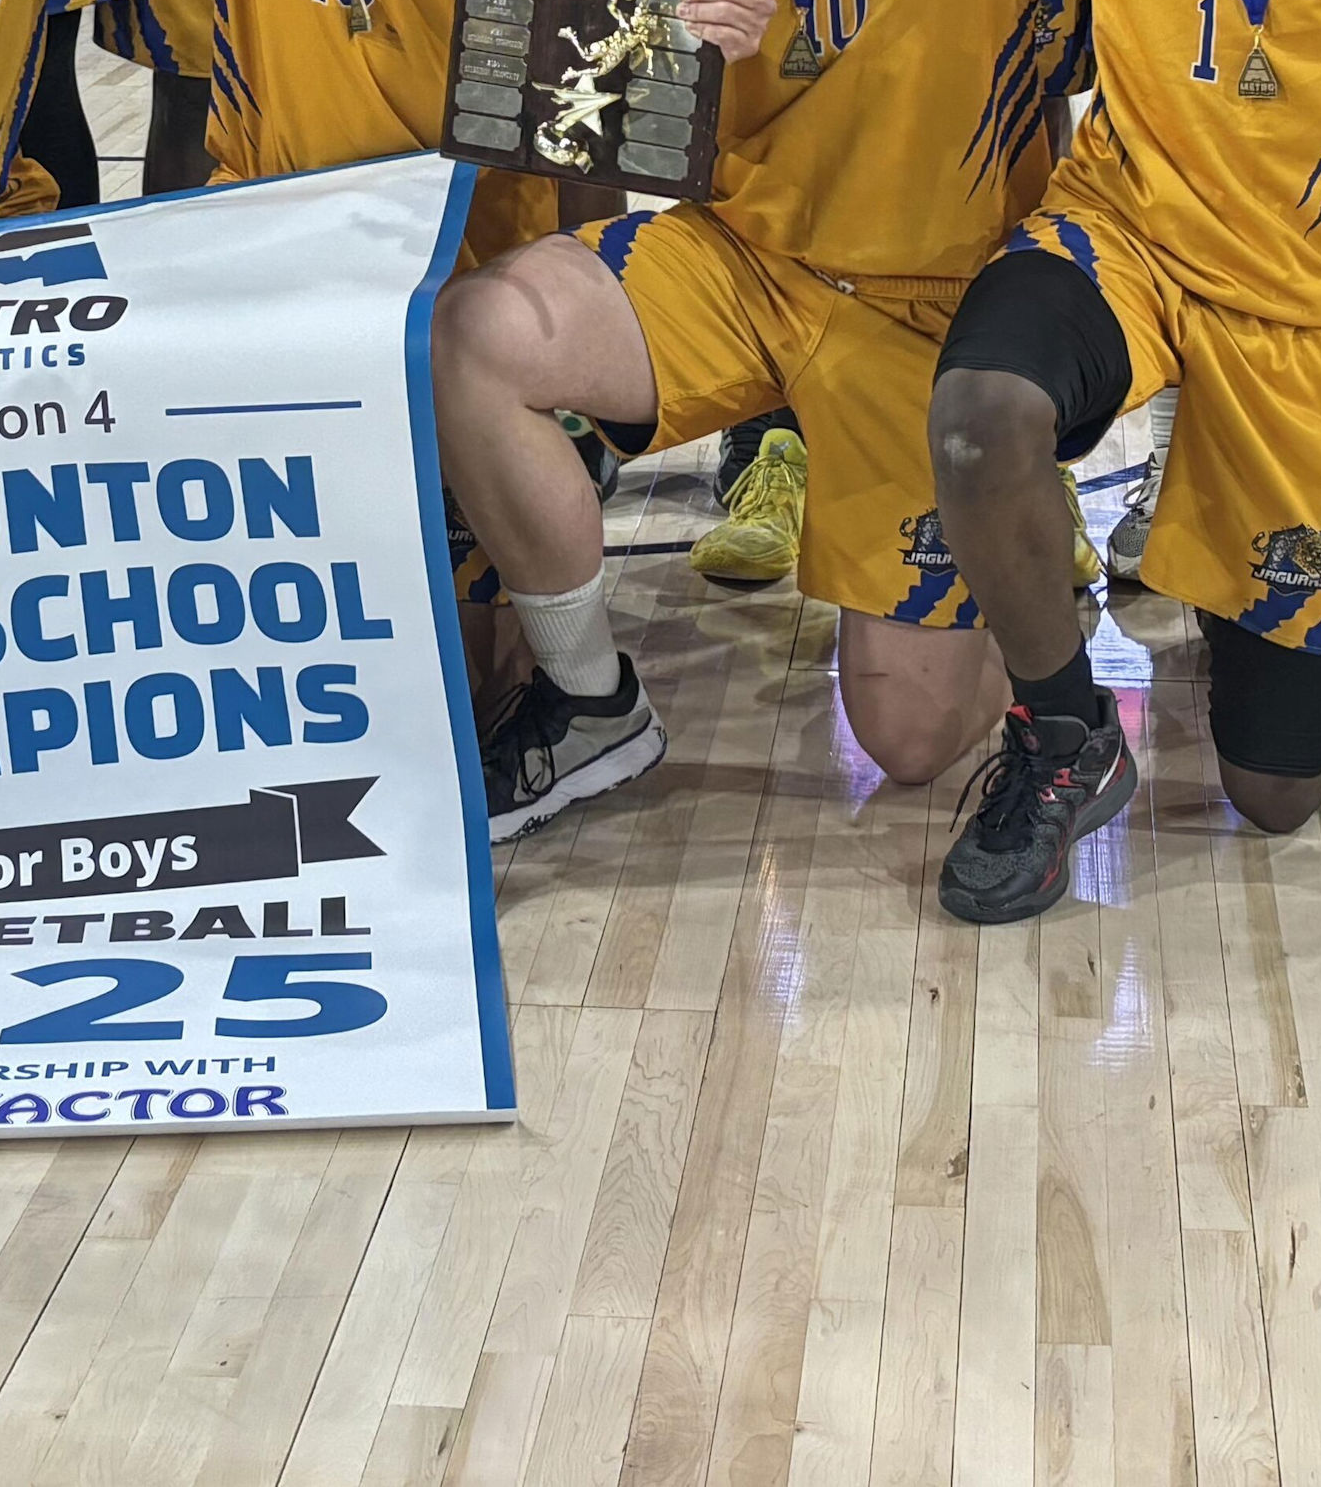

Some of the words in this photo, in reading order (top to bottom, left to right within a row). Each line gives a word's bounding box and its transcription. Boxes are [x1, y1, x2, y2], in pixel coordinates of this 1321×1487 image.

[84, 391, 115, 434] 4
[62, 829, 198, 884] Boys
[142, 1056, 276, 1075] WITH
